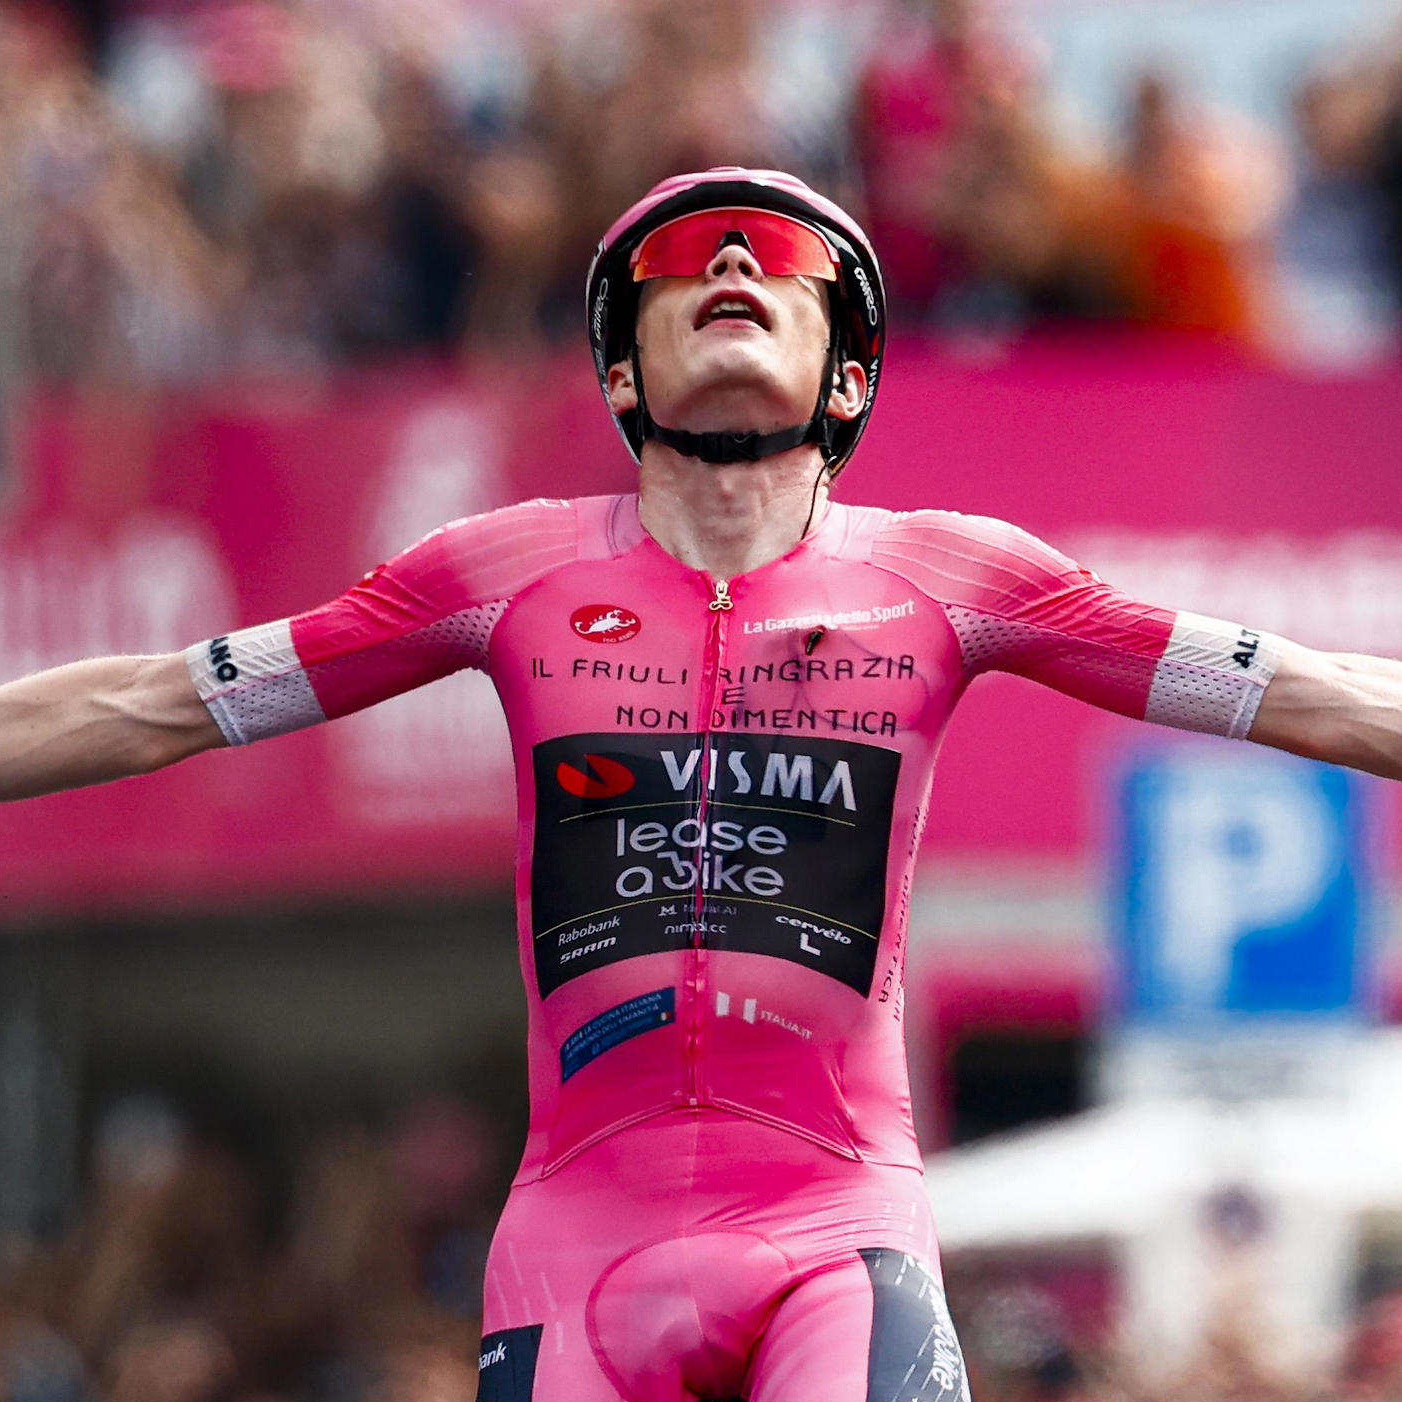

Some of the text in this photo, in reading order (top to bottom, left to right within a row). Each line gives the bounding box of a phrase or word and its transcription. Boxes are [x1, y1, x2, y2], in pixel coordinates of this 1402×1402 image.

[743, 621, 763, 634] La
[872, 599, 916, 622] Sport
[532, 655, 914, 685] IL FRIULI RINGRAZIA
[722, 687, 745, 705] E
[616, 705, 897, 737] NON DIMENTICA
[660, 749, 858, 812] VISMA
[616, 819, 788, 857] lease
[1155, 762, 1330, 995] P
[558, 915, 622, 947] Rabobank
[775, 915, 852, 945] cervélo
[560, 936, 617, 964] SRAM
